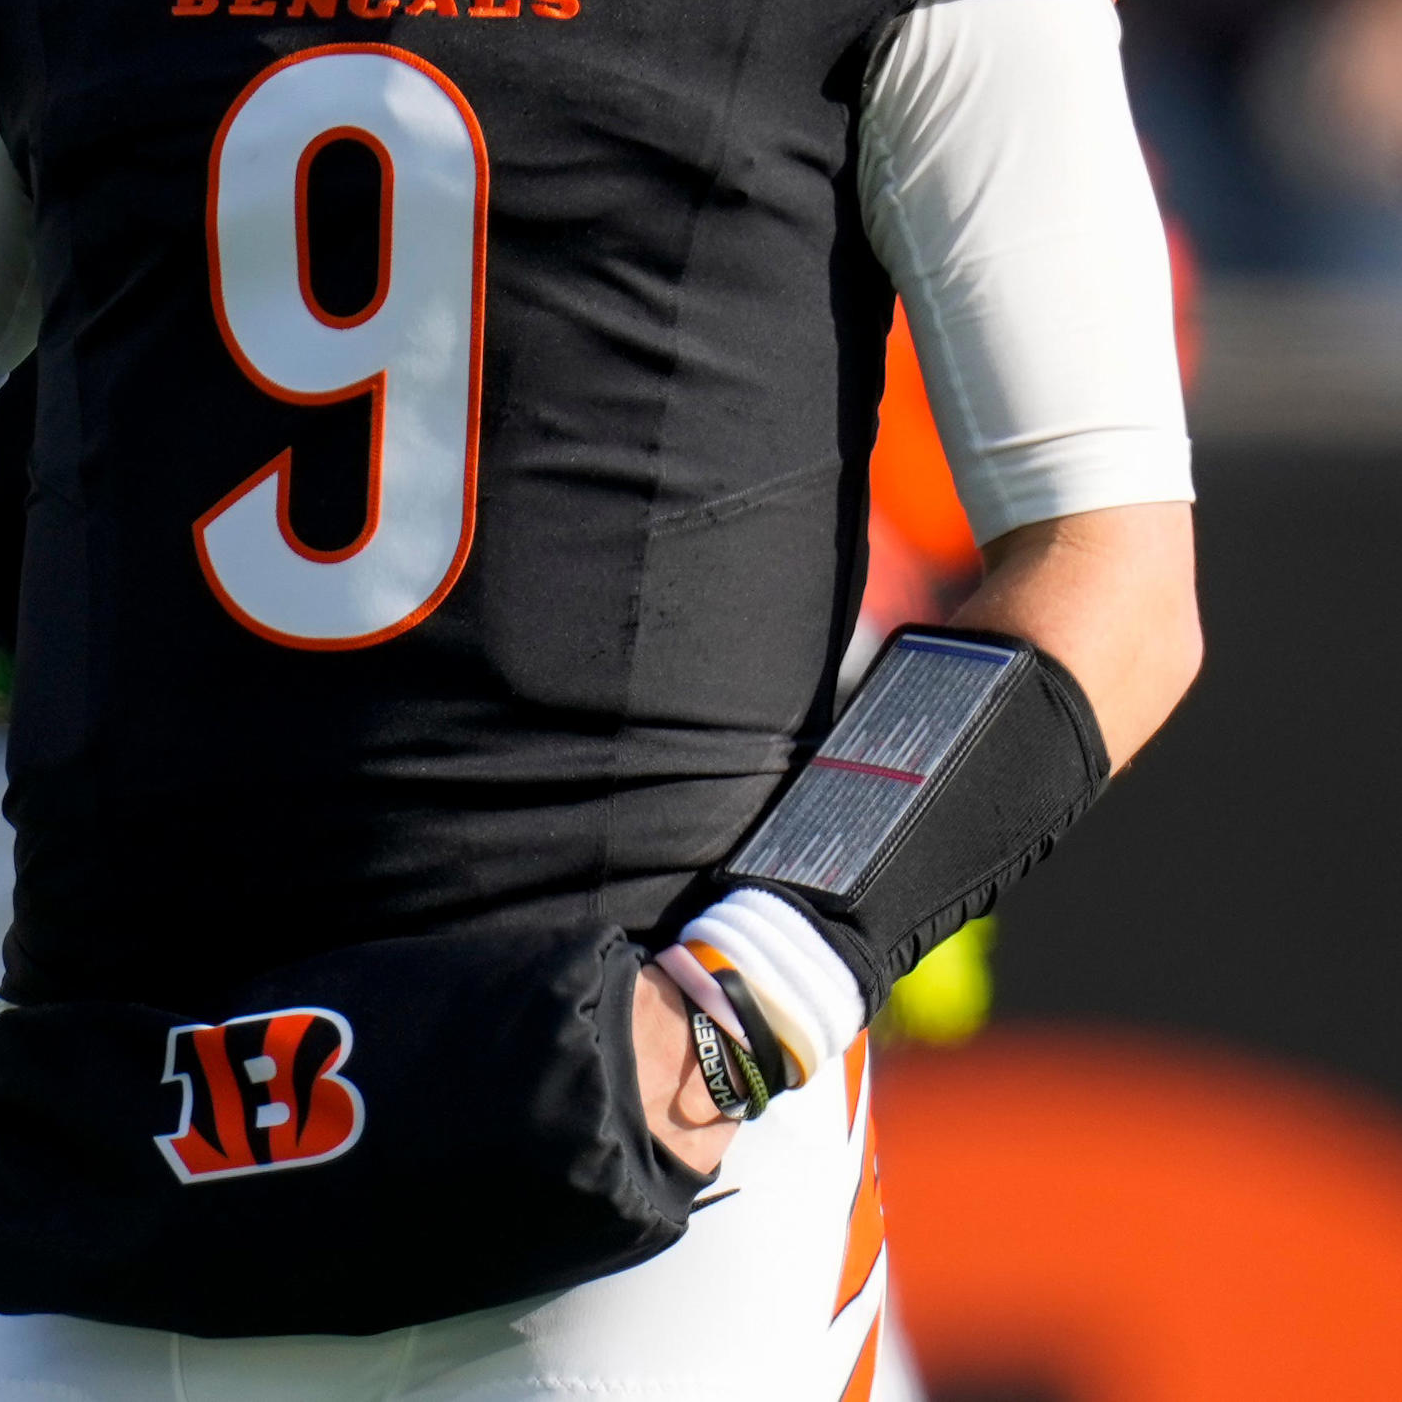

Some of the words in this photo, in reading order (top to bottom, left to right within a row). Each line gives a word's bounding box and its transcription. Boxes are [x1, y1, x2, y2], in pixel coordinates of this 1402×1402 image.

[193, 42, 490, 651] 9
[153, 1007, 366, 1185] B
[694, 1012, 736, 1107] HARDER
